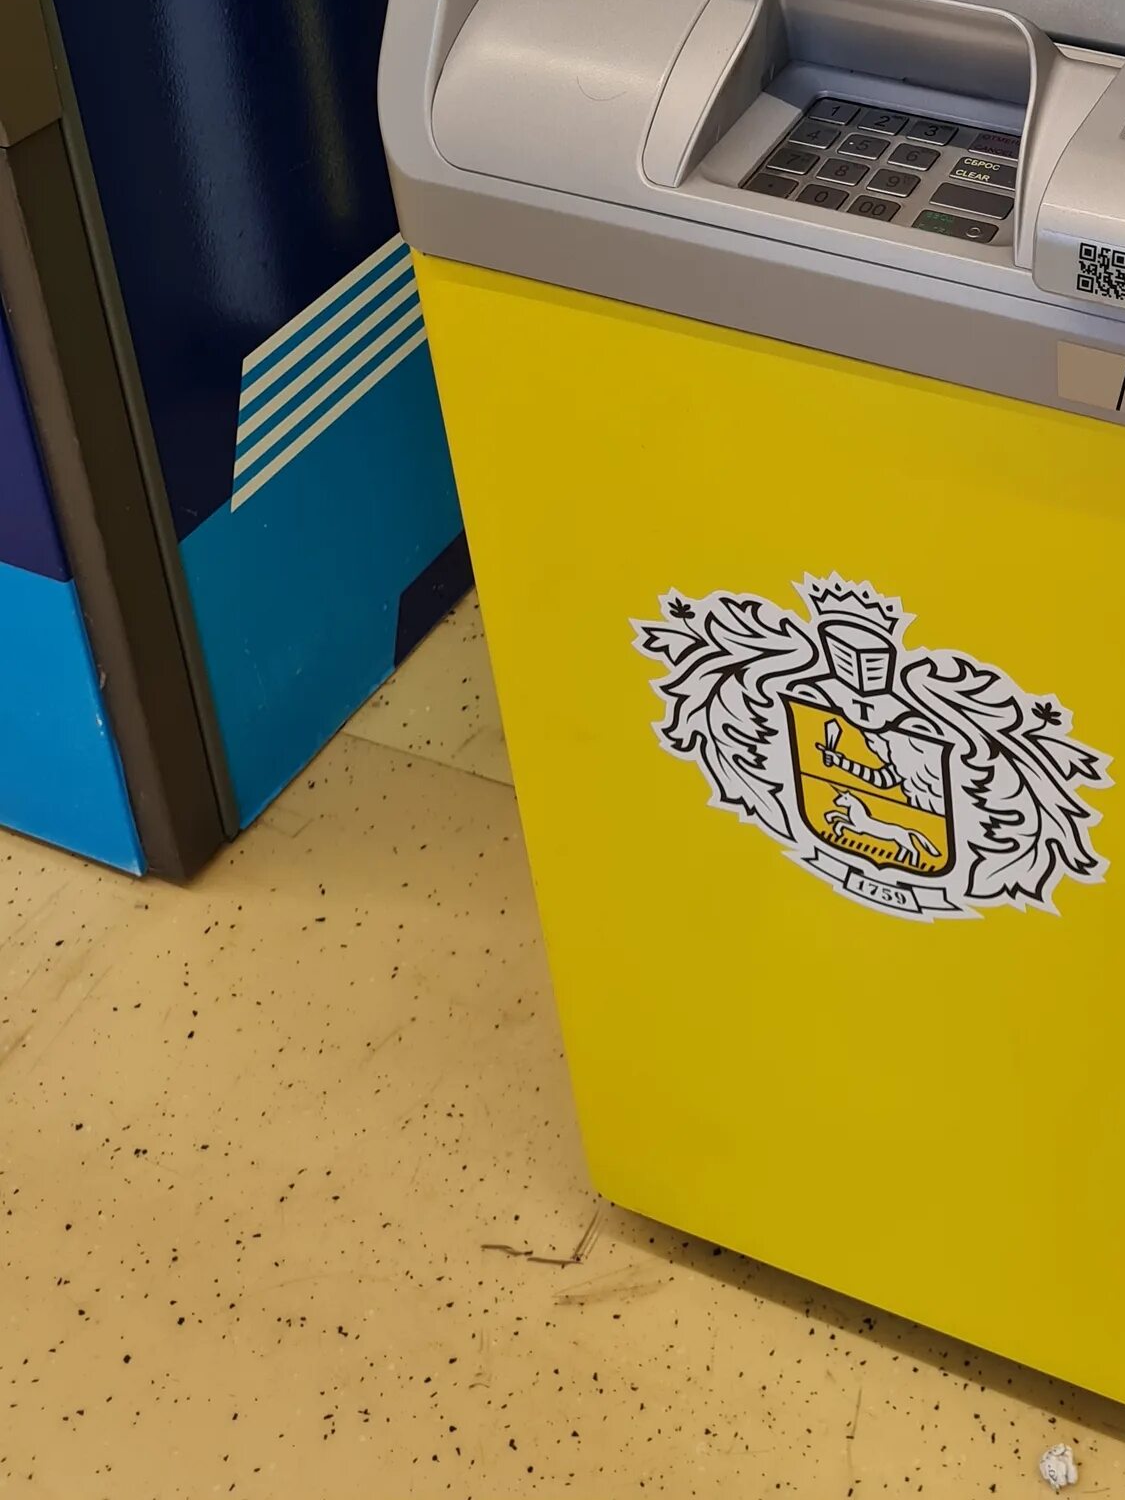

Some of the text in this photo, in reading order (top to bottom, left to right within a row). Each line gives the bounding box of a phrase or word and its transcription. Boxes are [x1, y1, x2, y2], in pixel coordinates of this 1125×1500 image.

[874, 115, 890, 128] 2
[924, 125, 939, 137] 3
[906, 150, 920, 163] 6
[964, 158, 1001, 171] СБРОС
[955, 169, 991, 182] CLEAR
[856, 879, 907, 905] 1759
